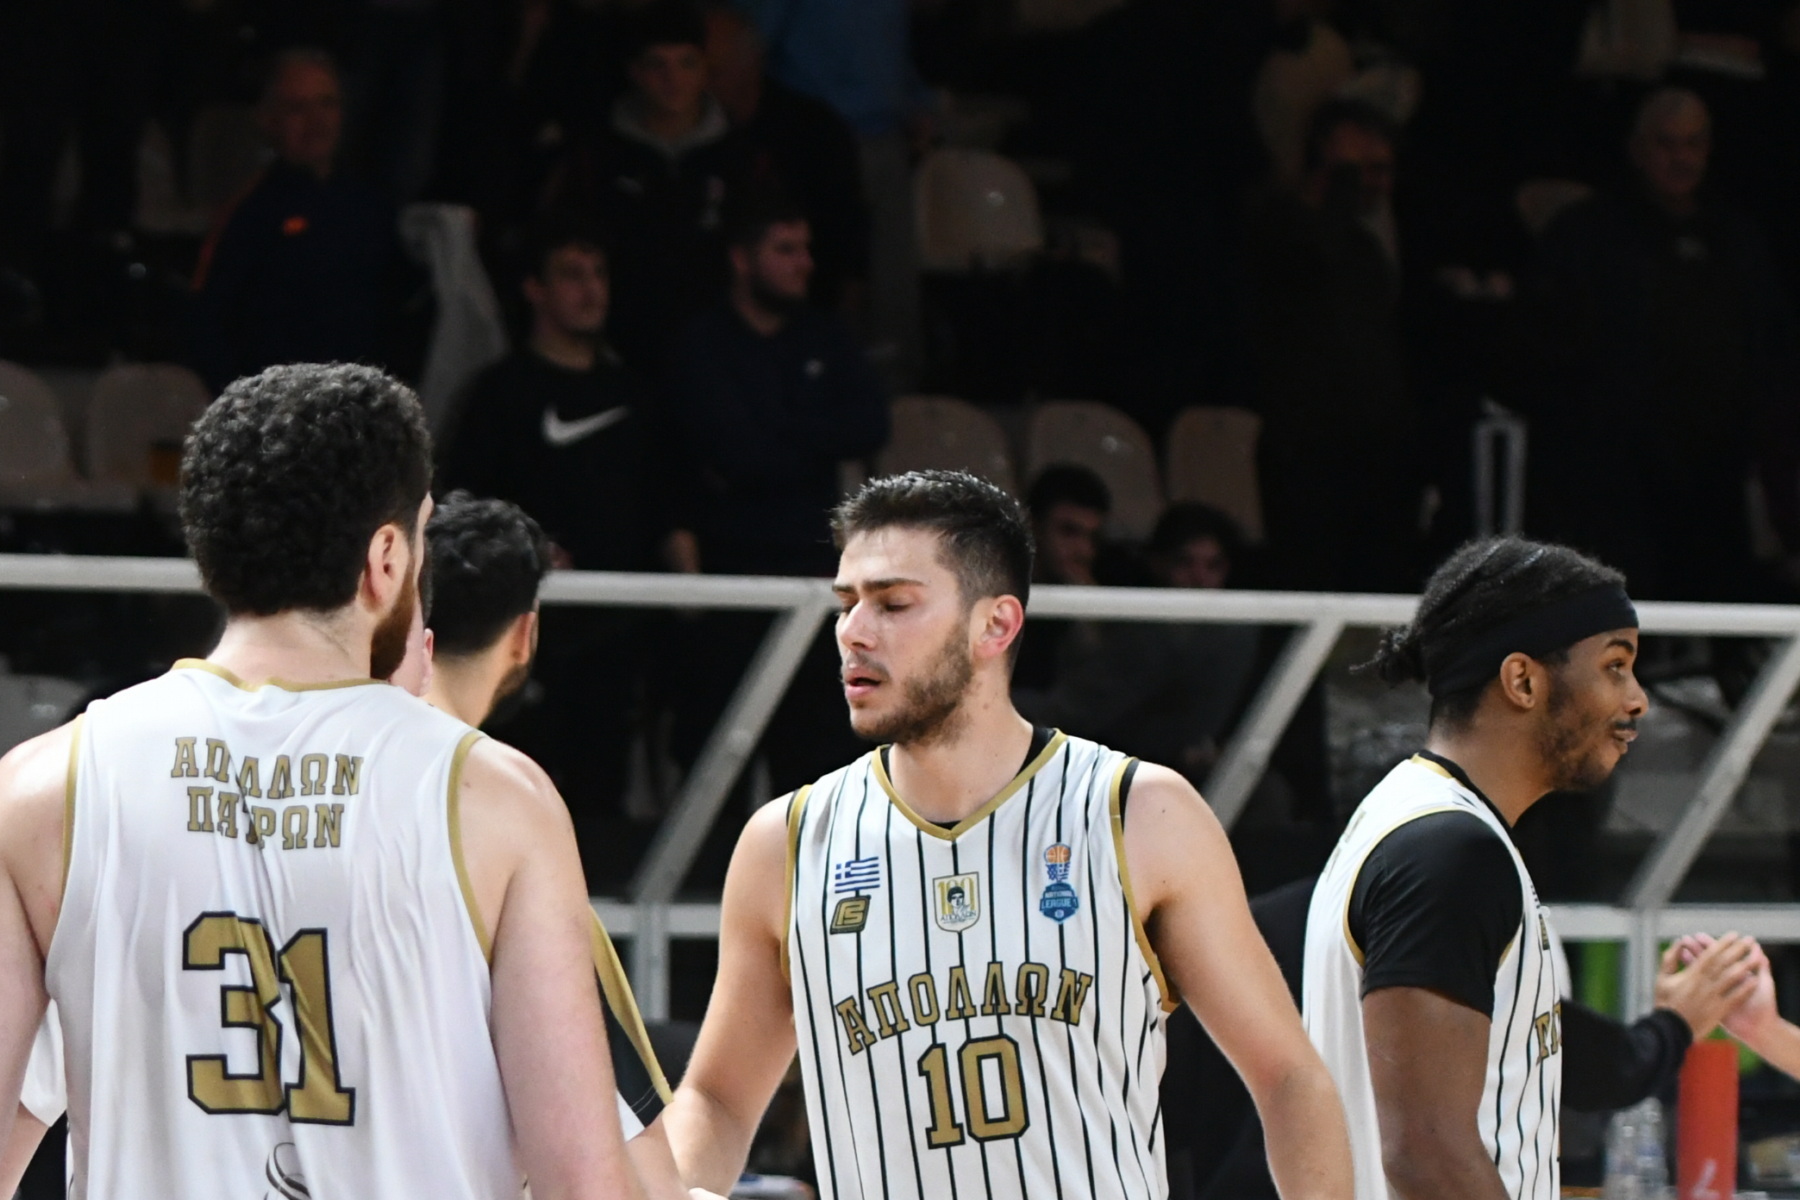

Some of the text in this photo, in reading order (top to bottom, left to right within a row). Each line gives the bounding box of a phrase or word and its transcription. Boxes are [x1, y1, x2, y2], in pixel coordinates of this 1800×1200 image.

[170, 736, 365, 799] ΑΠΛΛΩΝ
[182, 910, 355, 1126] 31
[835, 961, 1093, 1056] ΑΠΟΛΛΩΝ
[917, 1033, 1031, 1150] 10
